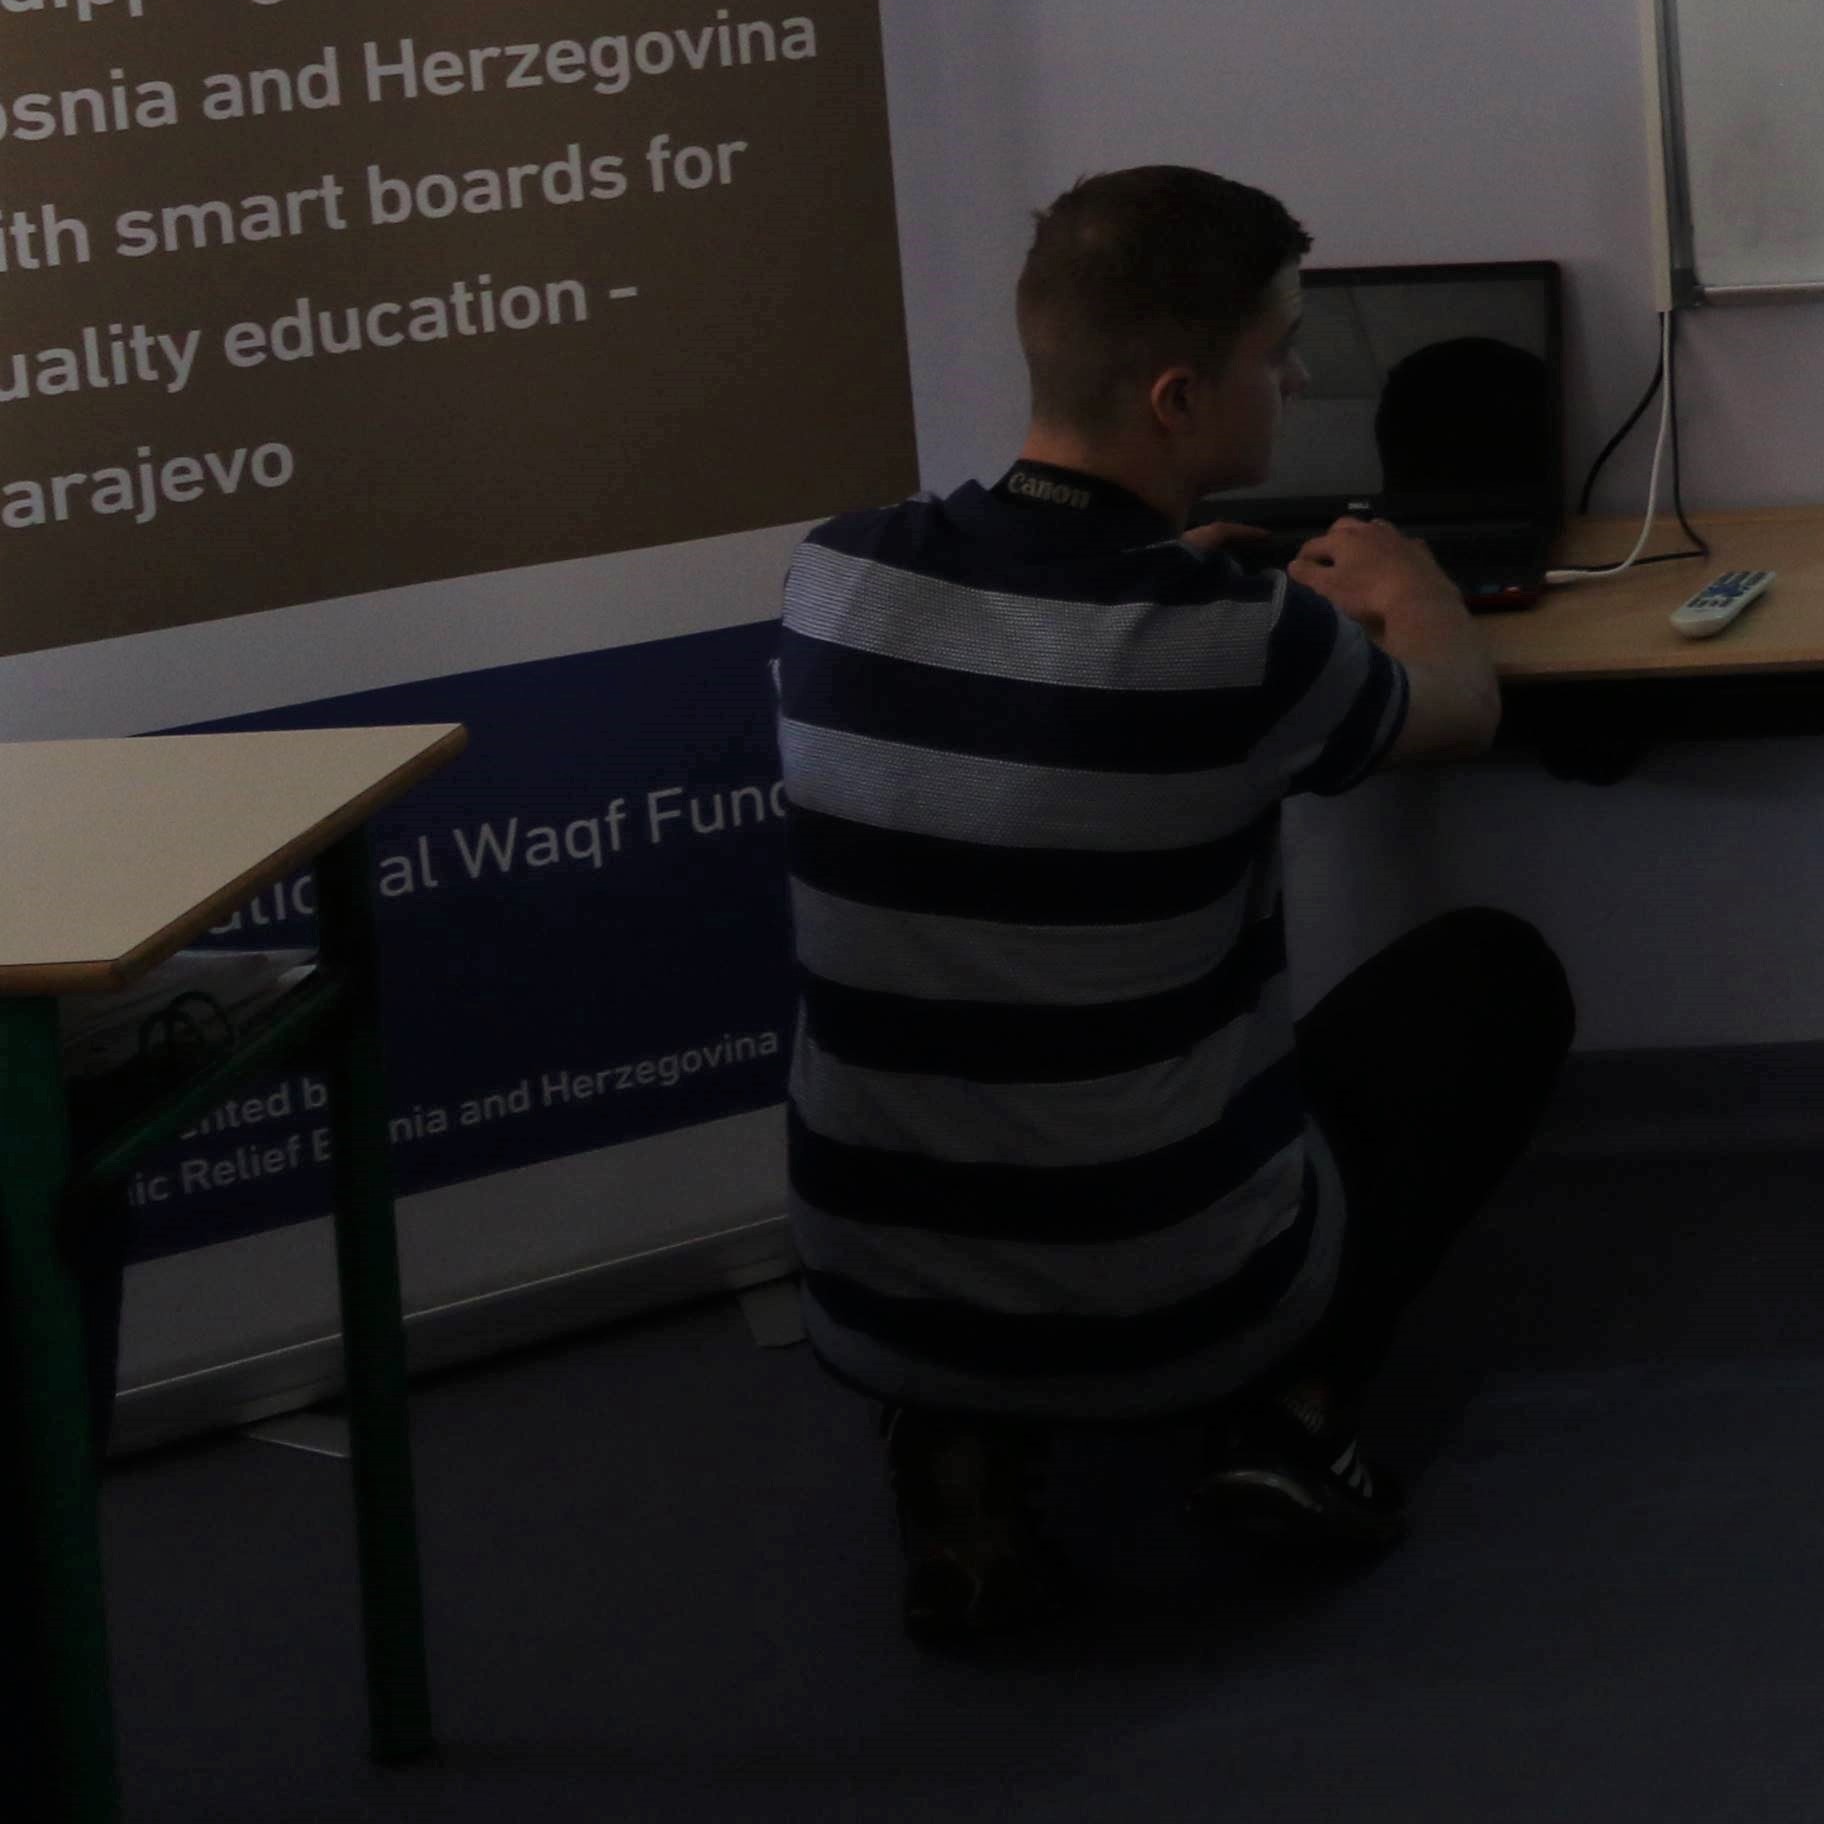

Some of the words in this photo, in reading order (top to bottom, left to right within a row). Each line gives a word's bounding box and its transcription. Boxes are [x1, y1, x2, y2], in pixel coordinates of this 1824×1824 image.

[0, 68, 178, 142] snia
[203, 46, 341, 120] and
[363, 10, 816, 102] Herzegovina
[115, 174, 347, 258] smart
[368, 143, 628, 225] boards
[645, 133, 747, 193] for
[223, 273, 588, 368] education
[1008, 471, 1090, 510] Canon
[452, 797, 627, 879] Waqf
[179, 1133, 302, 1195] Relief
[460, 1080, 531, 1126] and
[541, 1030, 780, 1106] Herzegovina
